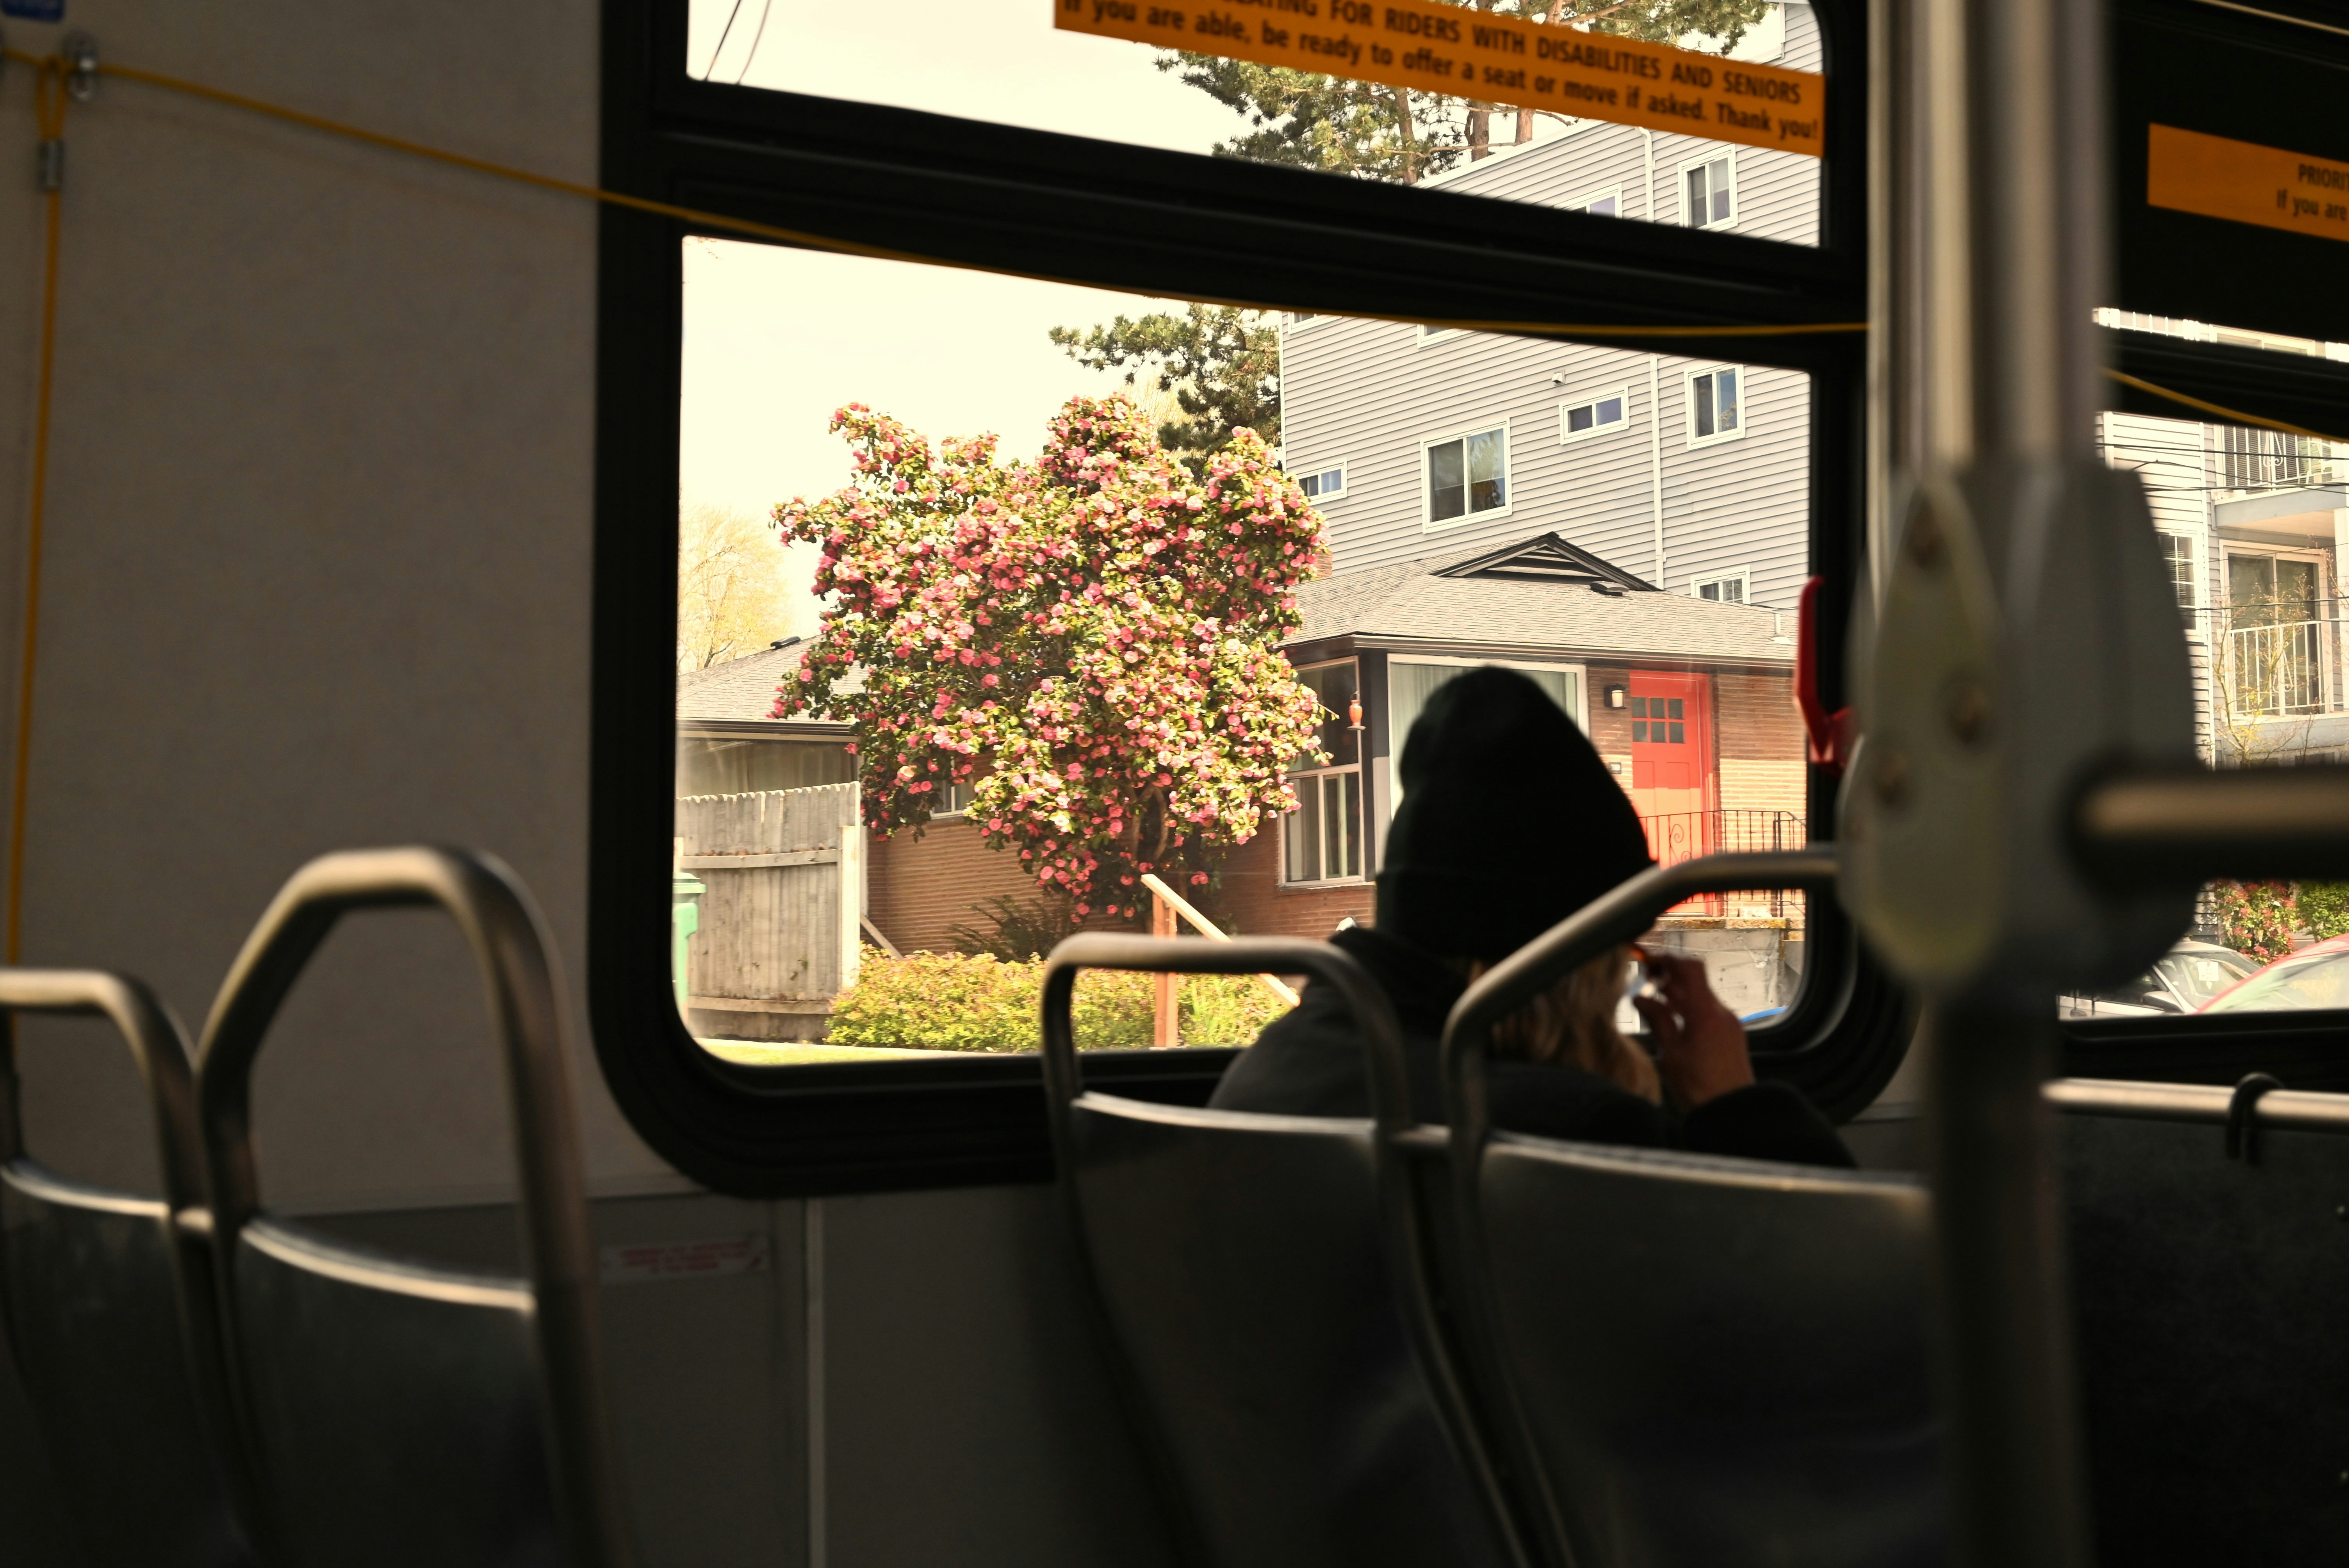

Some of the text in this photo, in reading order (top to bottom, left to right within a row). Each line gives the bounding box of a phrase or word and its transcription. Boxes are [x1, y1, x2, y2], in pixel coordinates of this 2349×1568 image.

[1093, 0, 1136, 22] you
[1147, 6, 1185, 30] are
[1195, 10, 1251, 43] able,
[1263, 20, 1287, 48] be
[1299, 33, 1361, 66] ready
[1371, 42, 1392, 65] to
[1403, 46, 1453, 76] offer
[1461, 62, 1474, 80] a
[1484, 66, 1526, 90] seat
[1535, 75, 1556, 94] or
[1565, 80, 1617, 106] move
[1626, 85, 1640, 108] if
[1647, 91, 1707, 120] asked.
[1717, 102, 1771, 131] Thank
[1779, 118, 1818, 141] you!
[1331, 0, 1372, 26] FOR
[1386, 7, 1460, 42] RIDERS
[1472, 23, 1525, 55] WITH
[1538, 36, 1661, 80] DISABILITIES
[1672, 61, 1713, 88] AND
[1723, 71, 1801, 104] SENIORS
[2277, 189, 2347, 221] If you are
